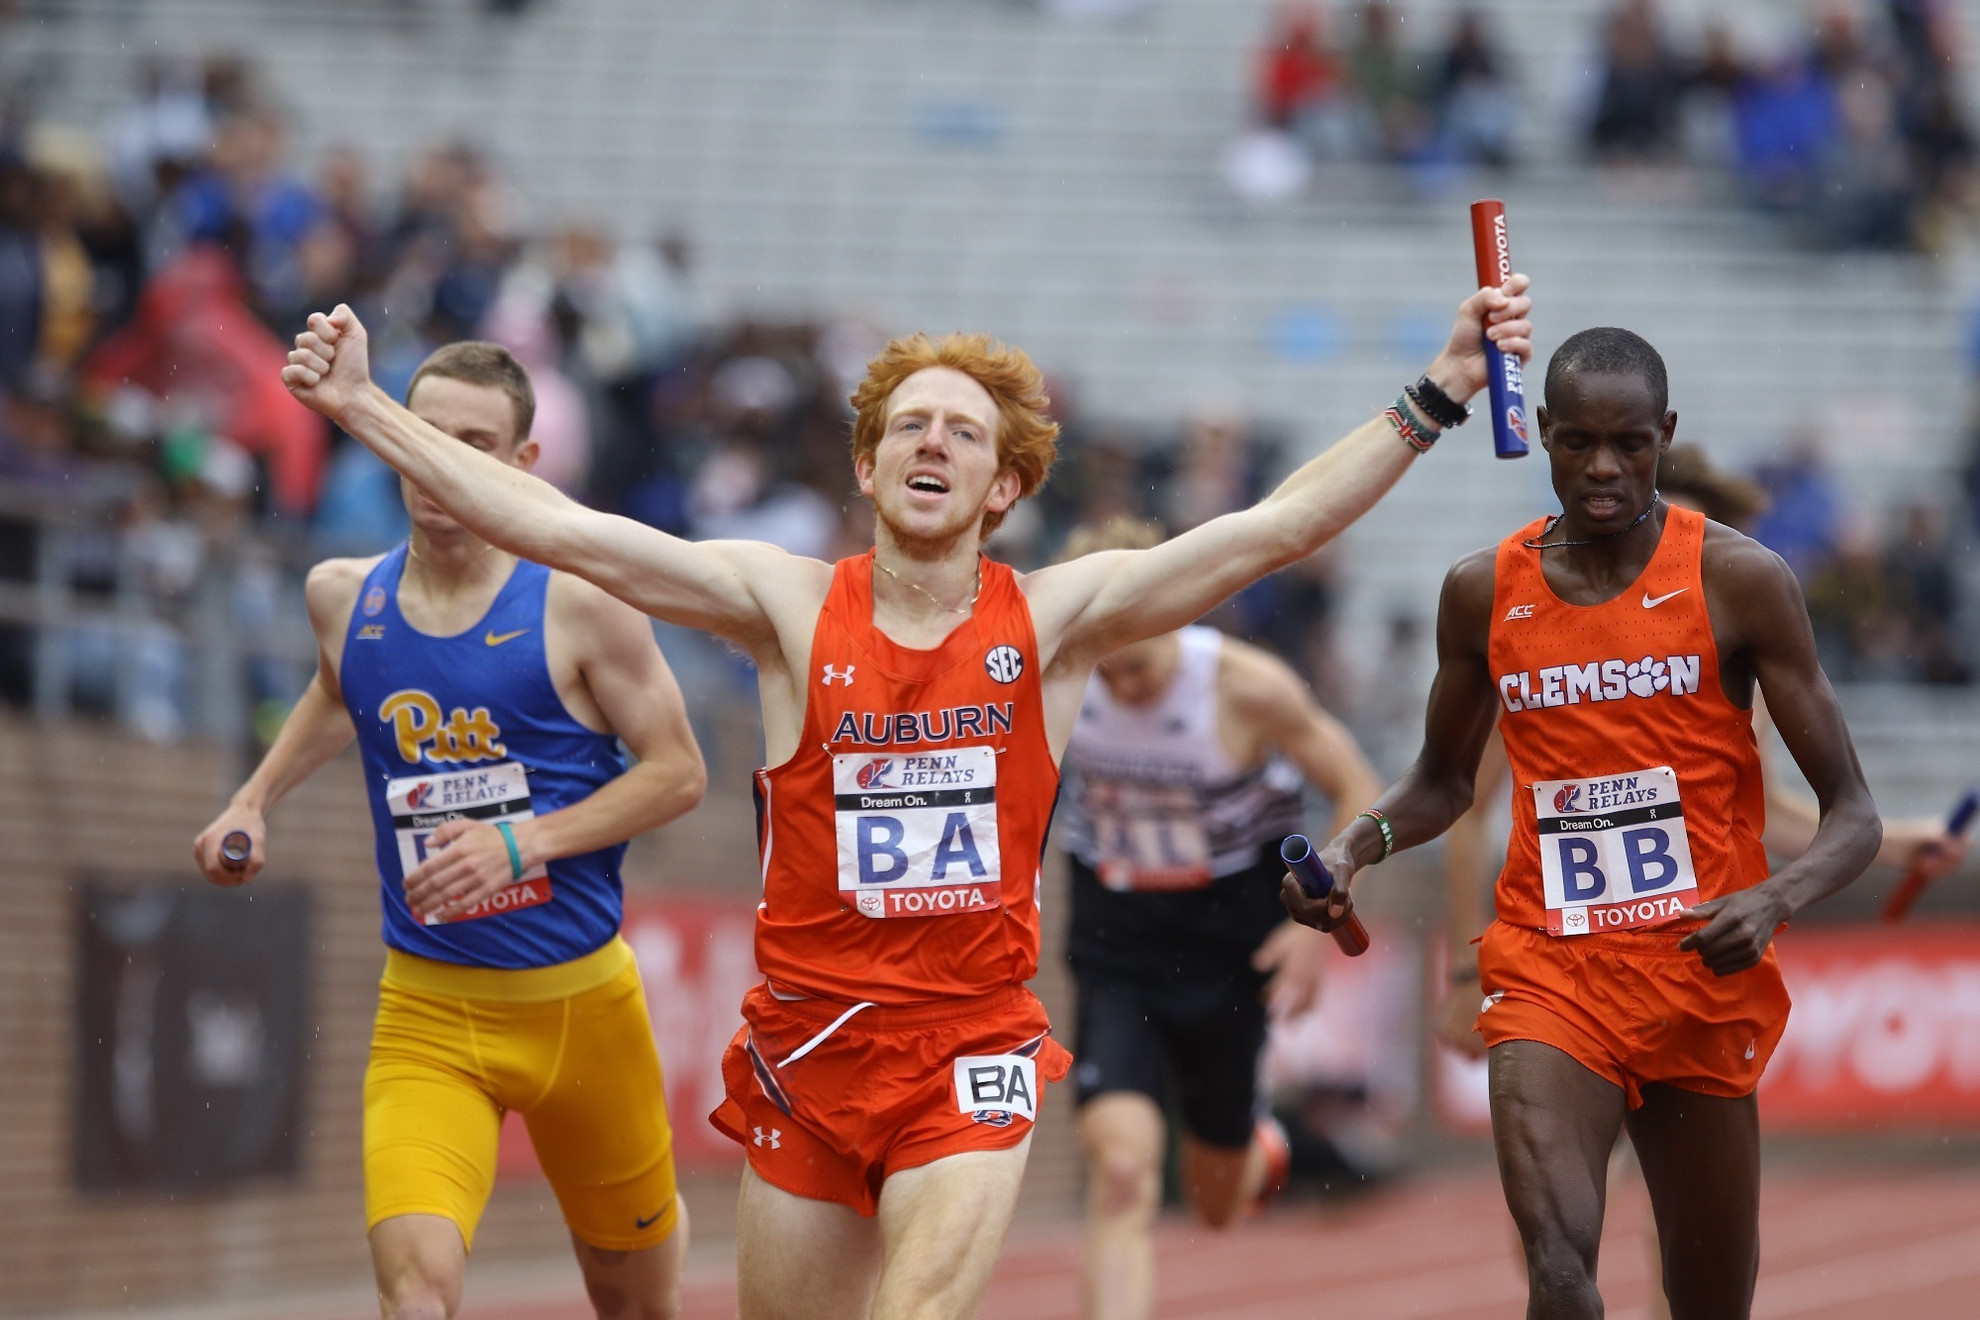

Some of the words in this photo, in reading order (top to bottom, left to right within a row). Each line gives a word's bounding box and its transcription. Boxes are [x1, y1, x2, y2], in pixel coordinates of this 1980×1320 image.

[1494, 213, 1511, 283] TOYOTA
[1507, 605, 1535, 620] ACC
[986, 646, 1022, 683] SEC
[379, 689, 507, 763] Pitt
[832, 703, 1014, 745] AUBURN
[903, 755, 958, 771] PENN
[442, 774, 488, 792] PENN
[901, 769, 974, 786] RELAYS
[1589, 777, 1639, 797] PENN
[443, 784, 508, 806] RELAYS
[861, 796, 902, 809] Dream
[904, 796, 927, 808] On.
[1588, 787, 1658, 811] RELAYS
[1560, 818, 1593, 832] Dream
[1594, 816, 1615, 829] On.
[890, 888, 985, 912] TOYOTA
[1594, 898, 1685, 928] TOYOTA
[968, 1064, 1033, 1112] BA
